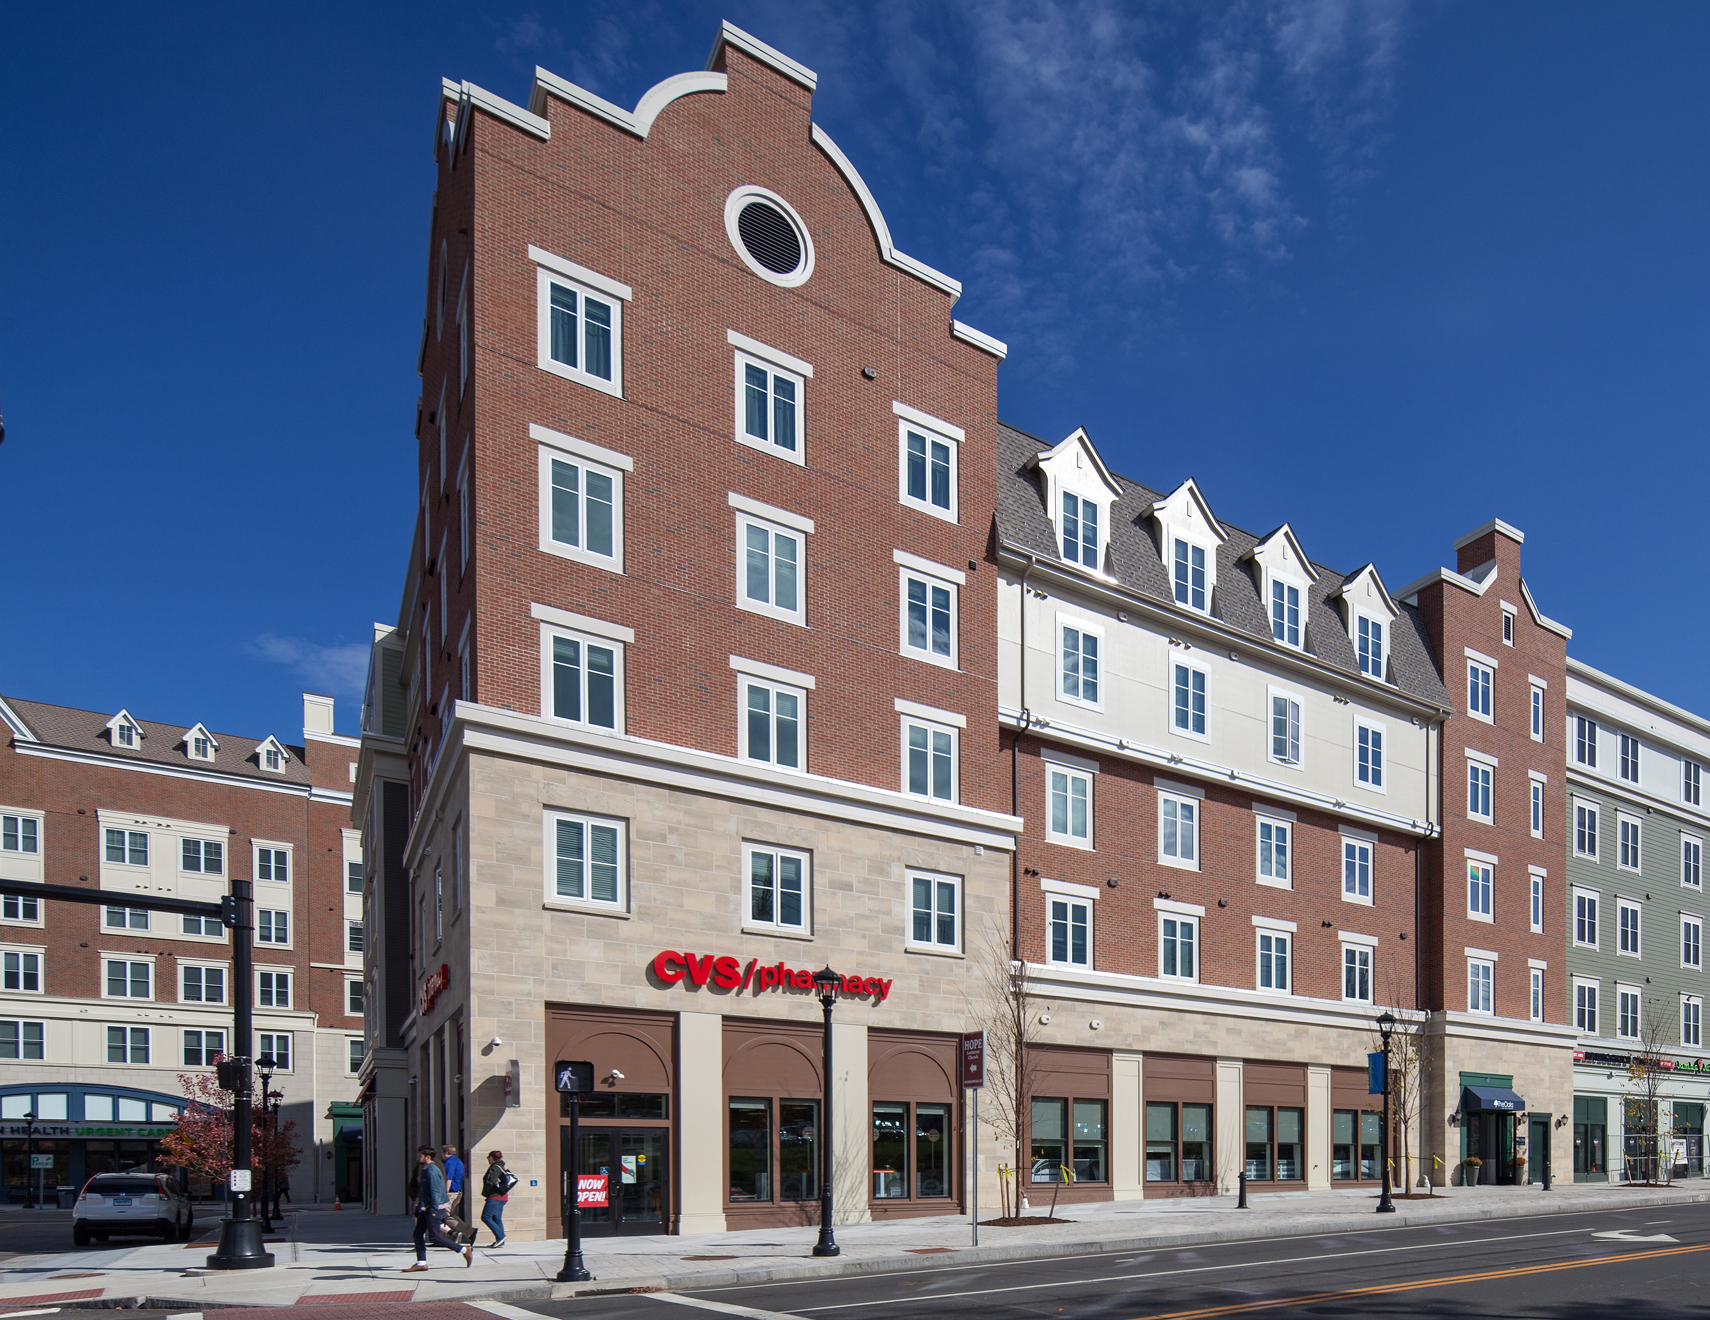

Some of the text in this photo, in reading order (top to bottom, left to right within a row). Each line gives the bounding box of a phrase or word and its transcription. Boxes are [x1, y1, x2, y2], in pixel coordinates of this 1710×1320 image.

[964, 1039, 982, 1050] HOPE
[10, 1126, 70, 1135] HEALTH
[74, 1127, 132, 1136] URGENT
[136, 1128, 173, 1136] CARE
[578, 1179, 604, 1189] NOW
